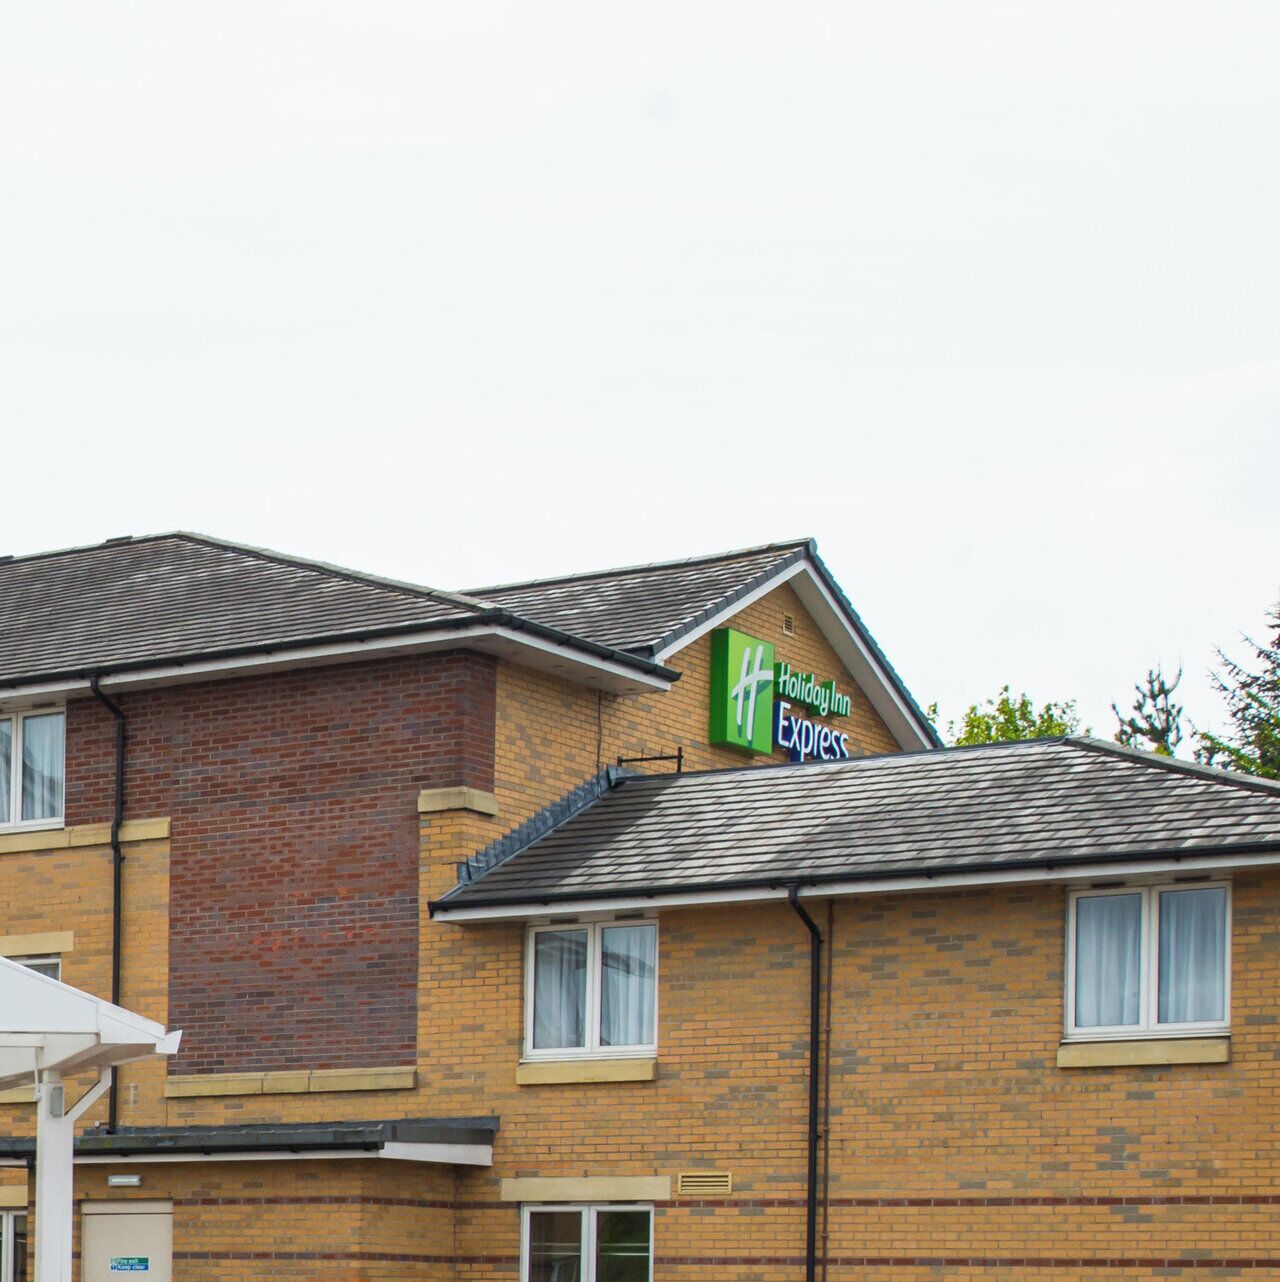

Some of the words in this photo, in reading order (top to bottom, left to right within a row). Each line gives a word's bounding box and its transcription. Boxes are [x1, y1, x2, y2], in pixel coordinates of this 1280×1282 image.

[778, 661, 830, 716] Holiday
[830, 680, 851, 717] Inn
[778, 701, 849, 762] Express
